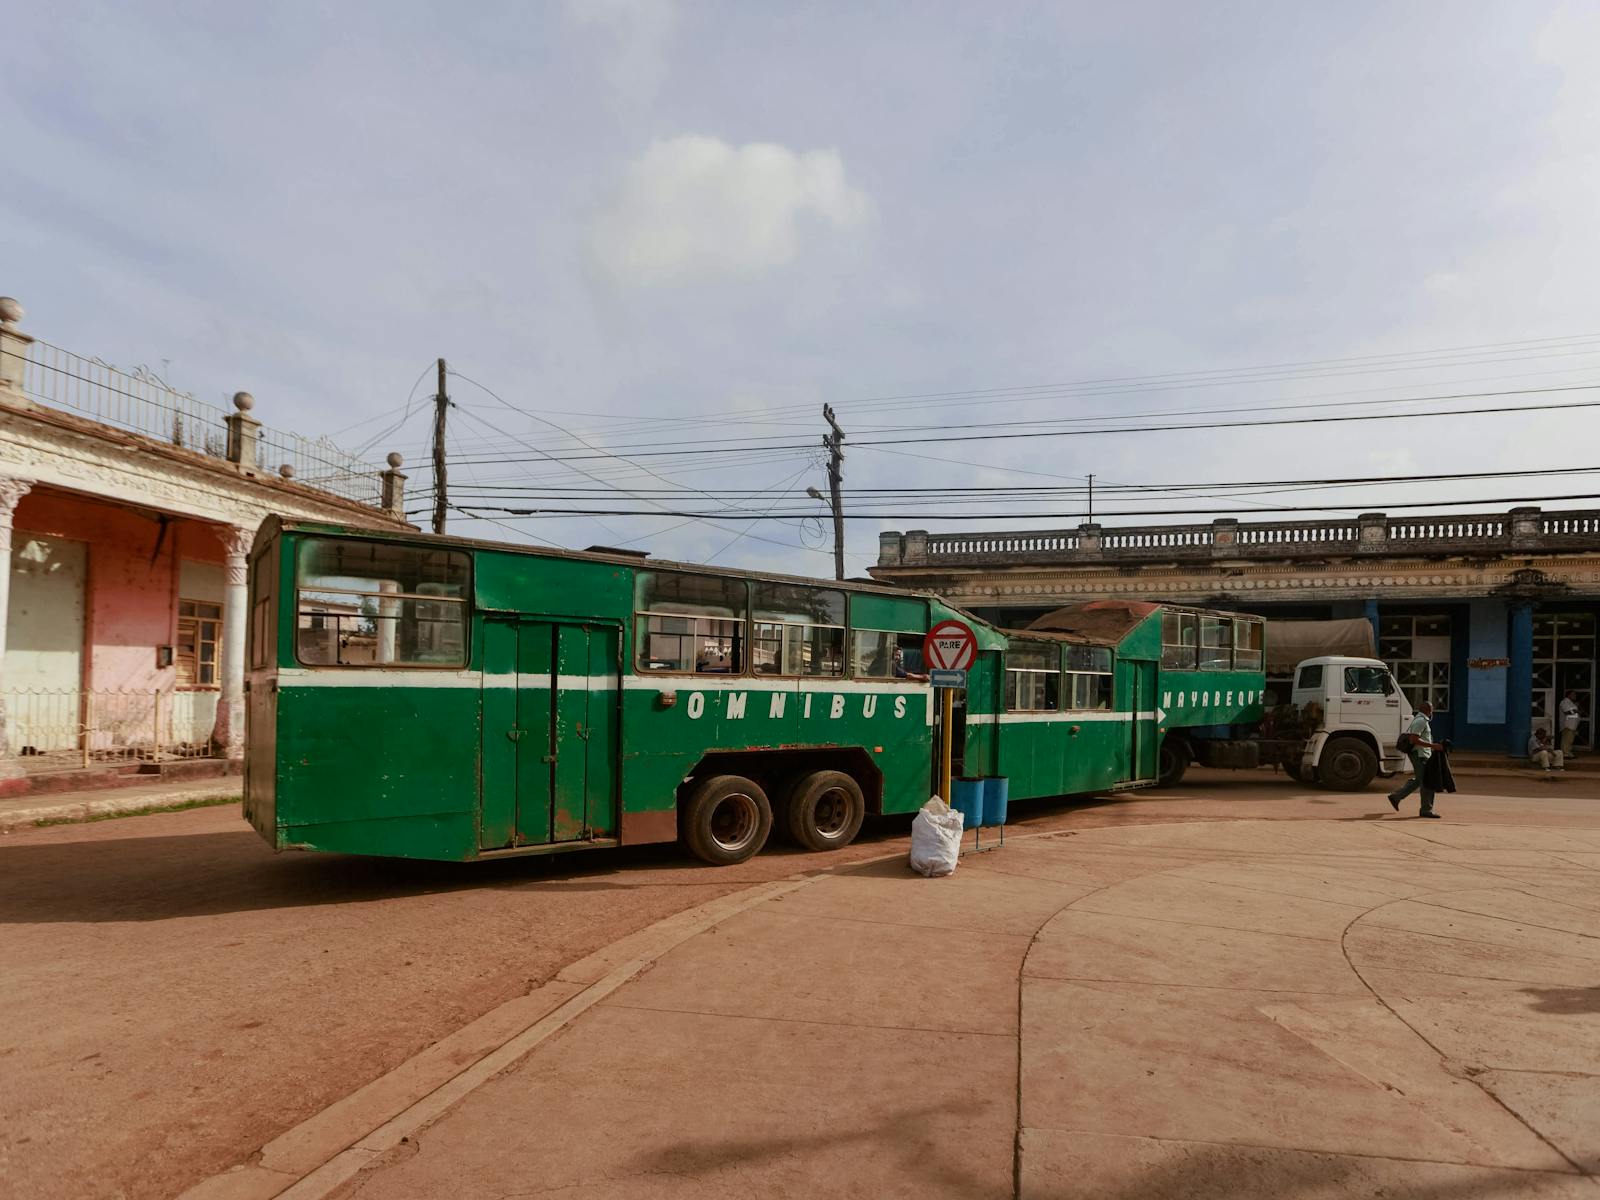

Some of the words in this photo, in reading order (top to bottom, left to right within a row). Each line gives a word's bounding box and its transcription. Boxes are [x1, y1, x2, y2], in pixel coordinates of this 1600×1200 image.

[939, 640, 961, 649] PARE
[687, 691, 907, 720] OMNIBUS
[1163, 690, 1264, 709] MAYABEQUE
